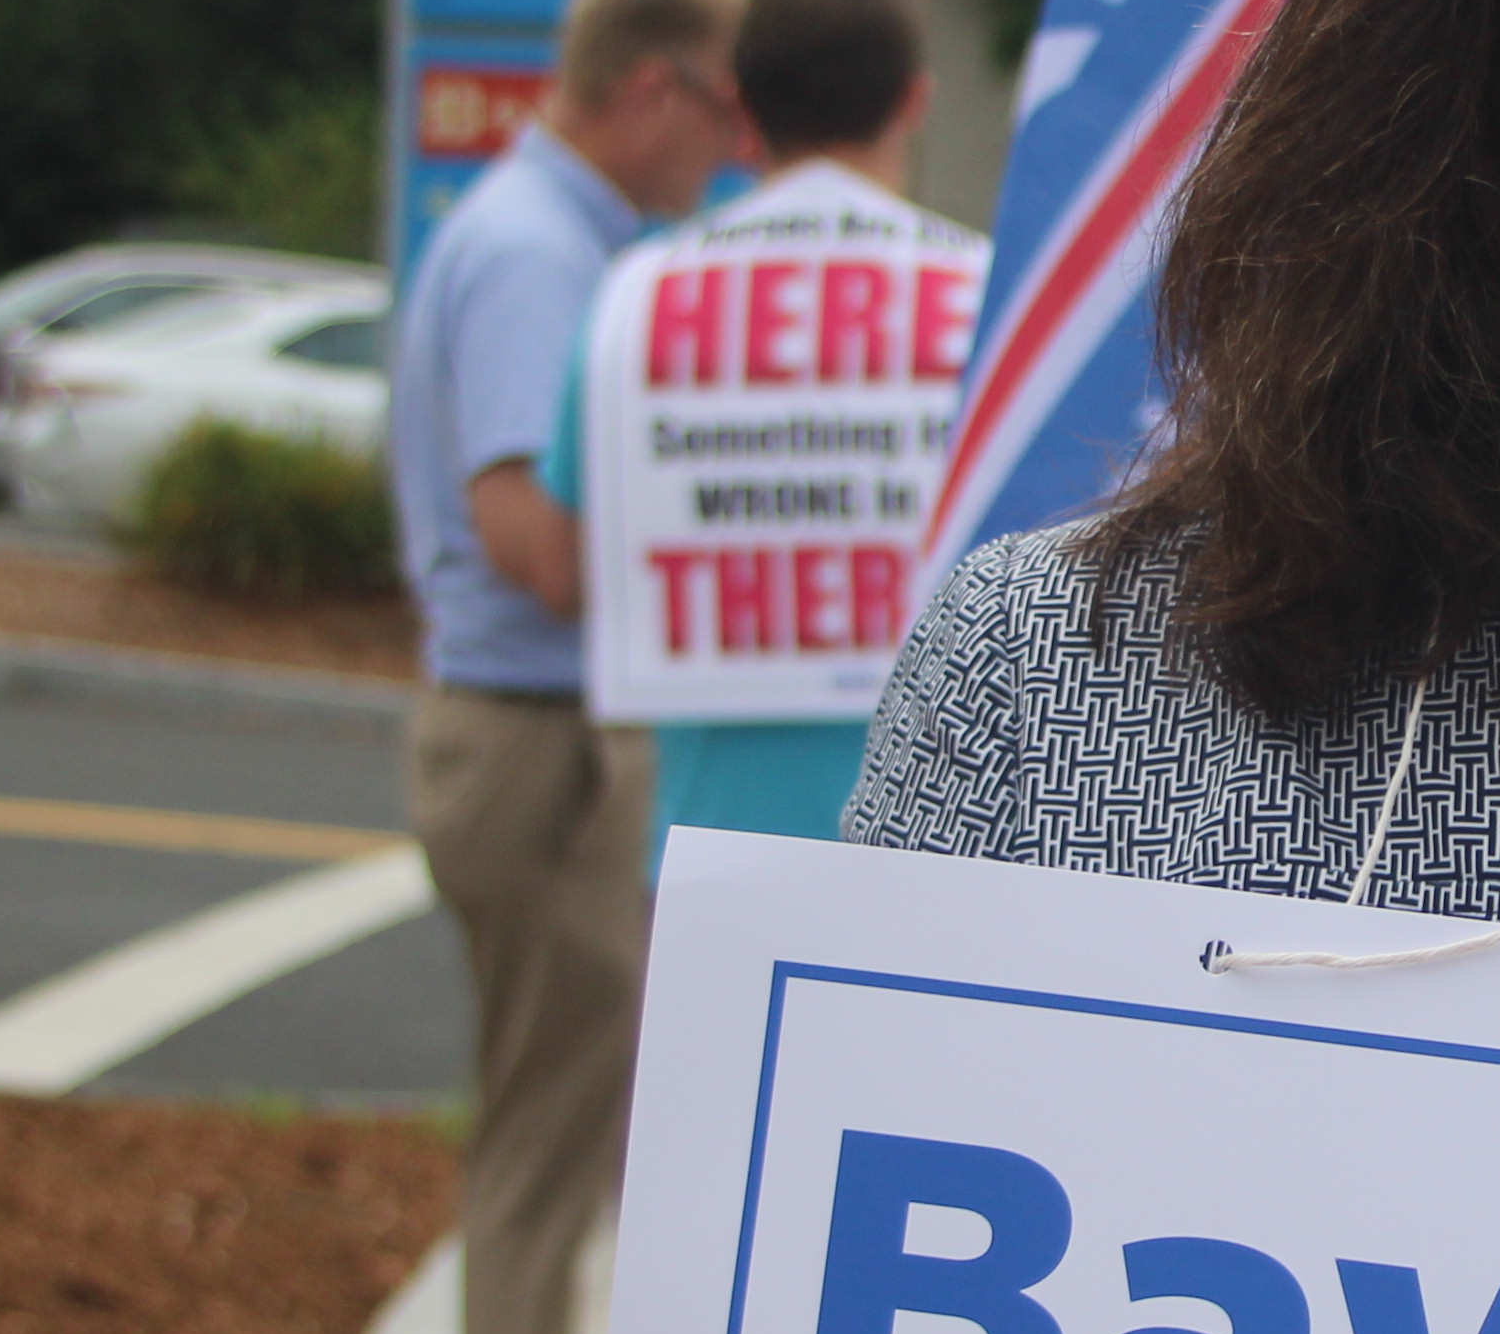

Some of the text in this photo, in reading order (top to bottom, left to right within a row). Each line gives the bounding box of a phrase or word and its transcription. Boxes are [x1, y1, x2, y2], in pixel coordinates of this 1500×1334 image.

[644, 257, 973, 388] HERE
[650, 416, 901, 463] Something
[647, 541, 911, 653] THER
